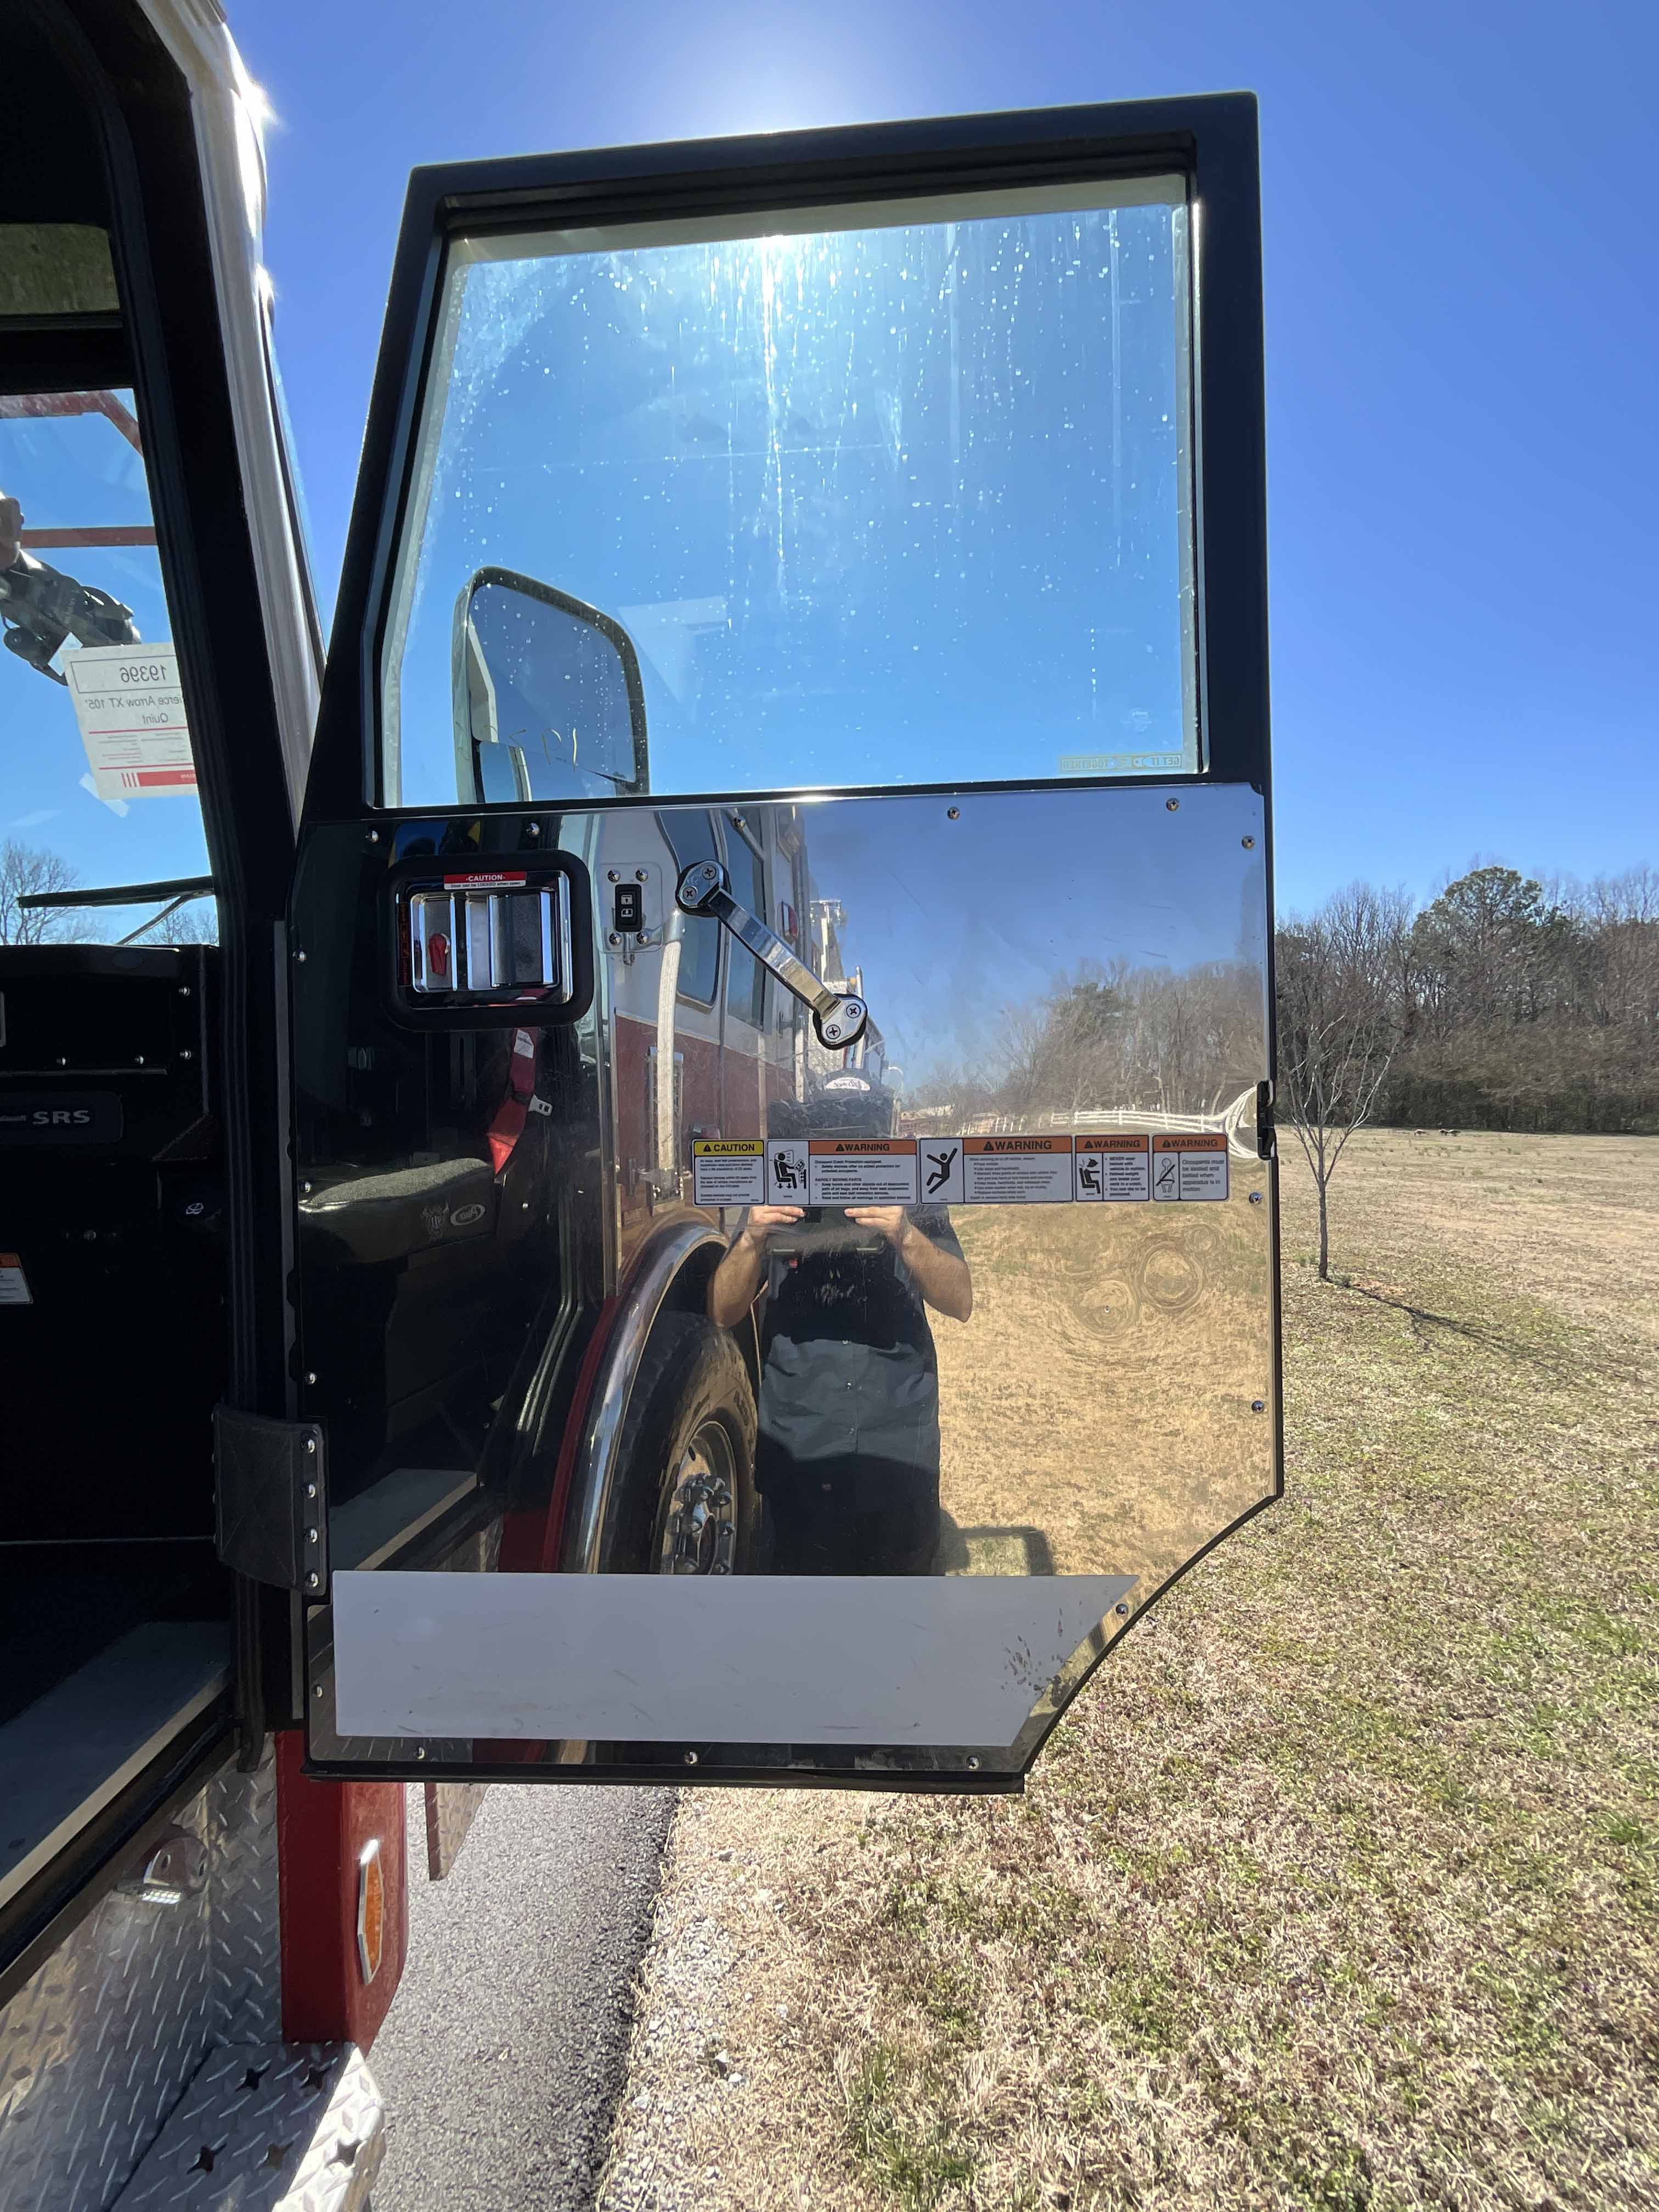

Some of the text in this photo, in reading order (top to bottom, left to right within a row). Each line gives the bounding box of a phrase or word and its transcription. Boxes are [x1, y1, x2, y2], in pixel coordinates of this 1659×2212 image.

[32, 1110, 90, 1125] SRS
[714, 1143, 755, 1152] CAUTION
[844, 1142, 890, 1152] WARNING
[995, 1140, 1053, 1151] WARNING
[1092, 1139, 1141, 1149] WARNING
[1170, 1138, 1218, 1148] WARNING
